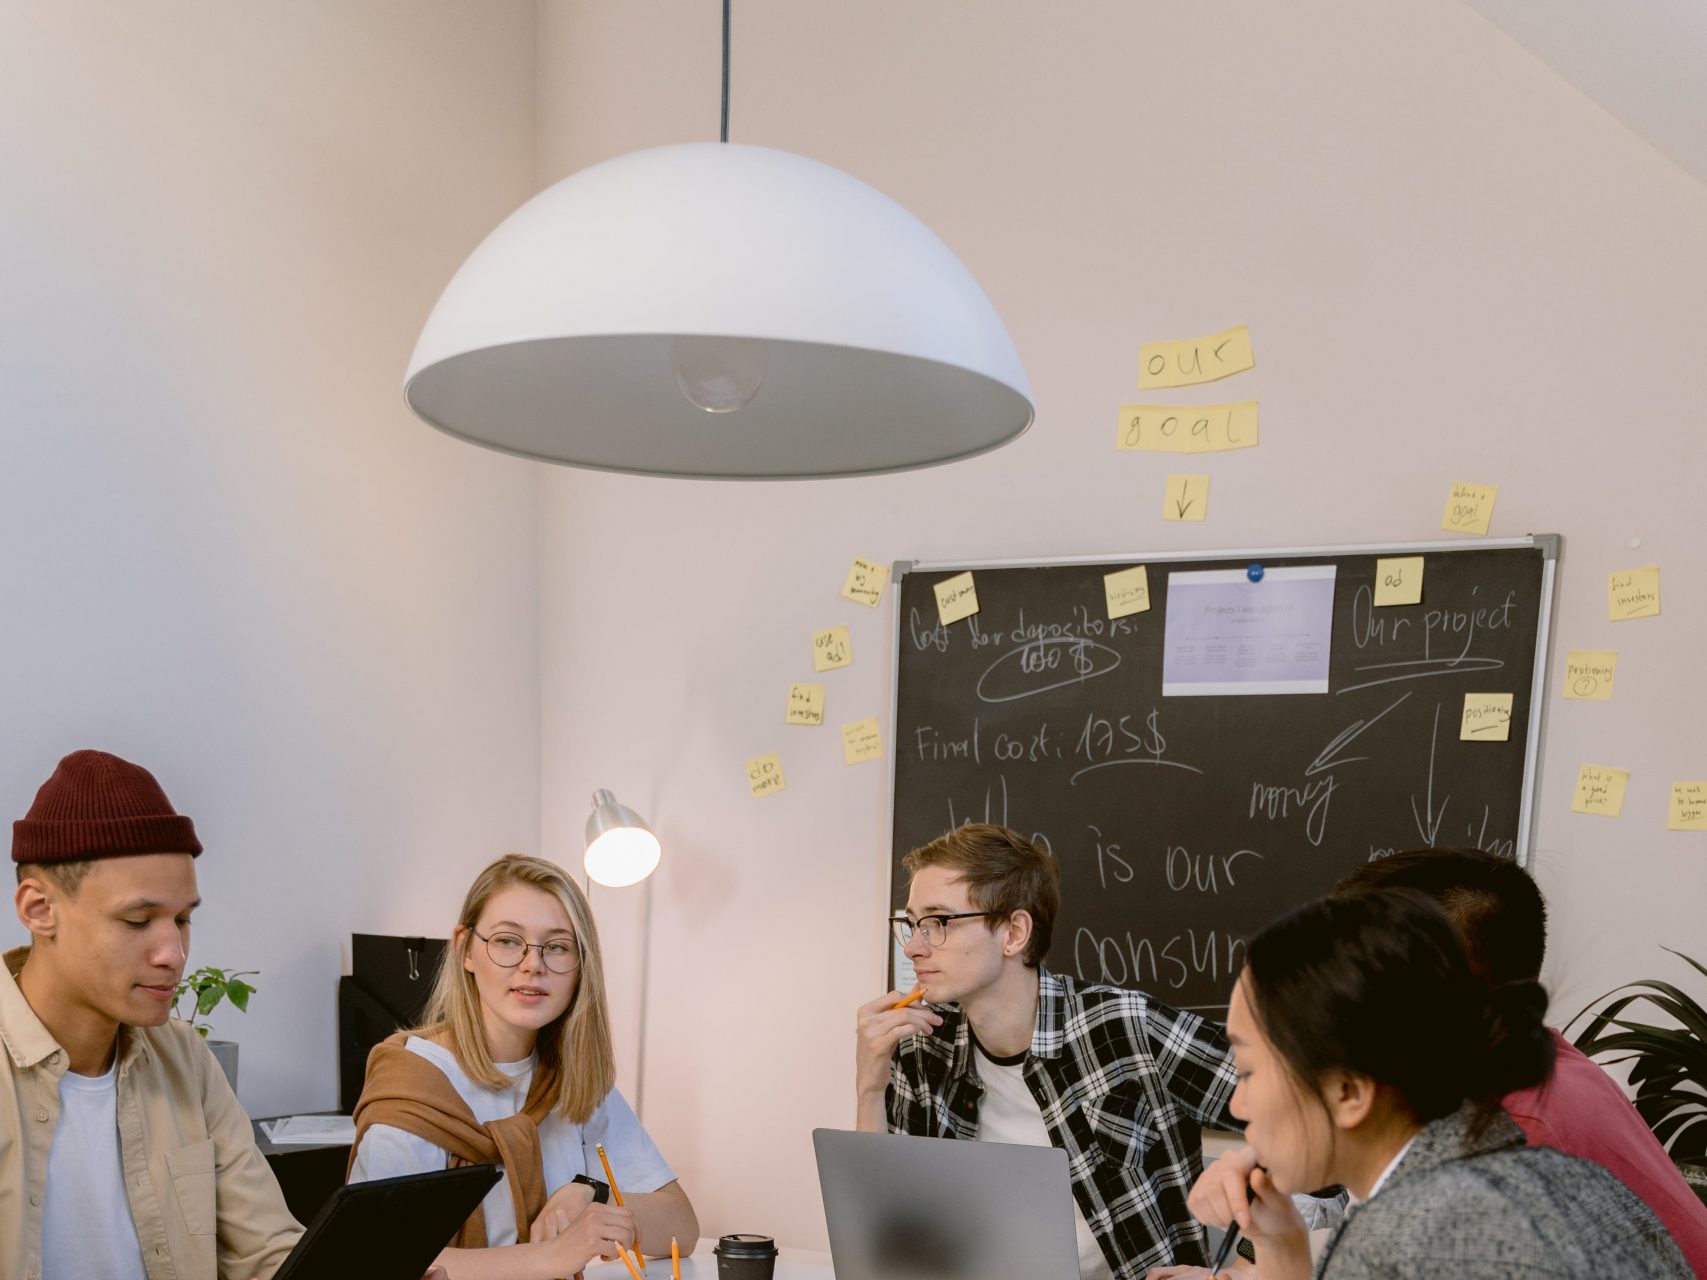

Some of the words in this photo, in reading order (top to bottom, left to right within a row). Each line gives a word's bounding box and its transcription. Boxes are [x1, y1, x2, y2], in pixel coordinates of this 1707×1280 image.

[1147, 338, 1233, 376] our
[1125, 409, 1241, 447] goal
[1384, 568, 1403, 588] ad
[1353, 585, 1411, 648] Our
[1423, 586, 1517, 667] project
[914, 716, 981, 765] Final
[1087, 825, 1134, 889] is
[1165, 846, 1265, 894] our
